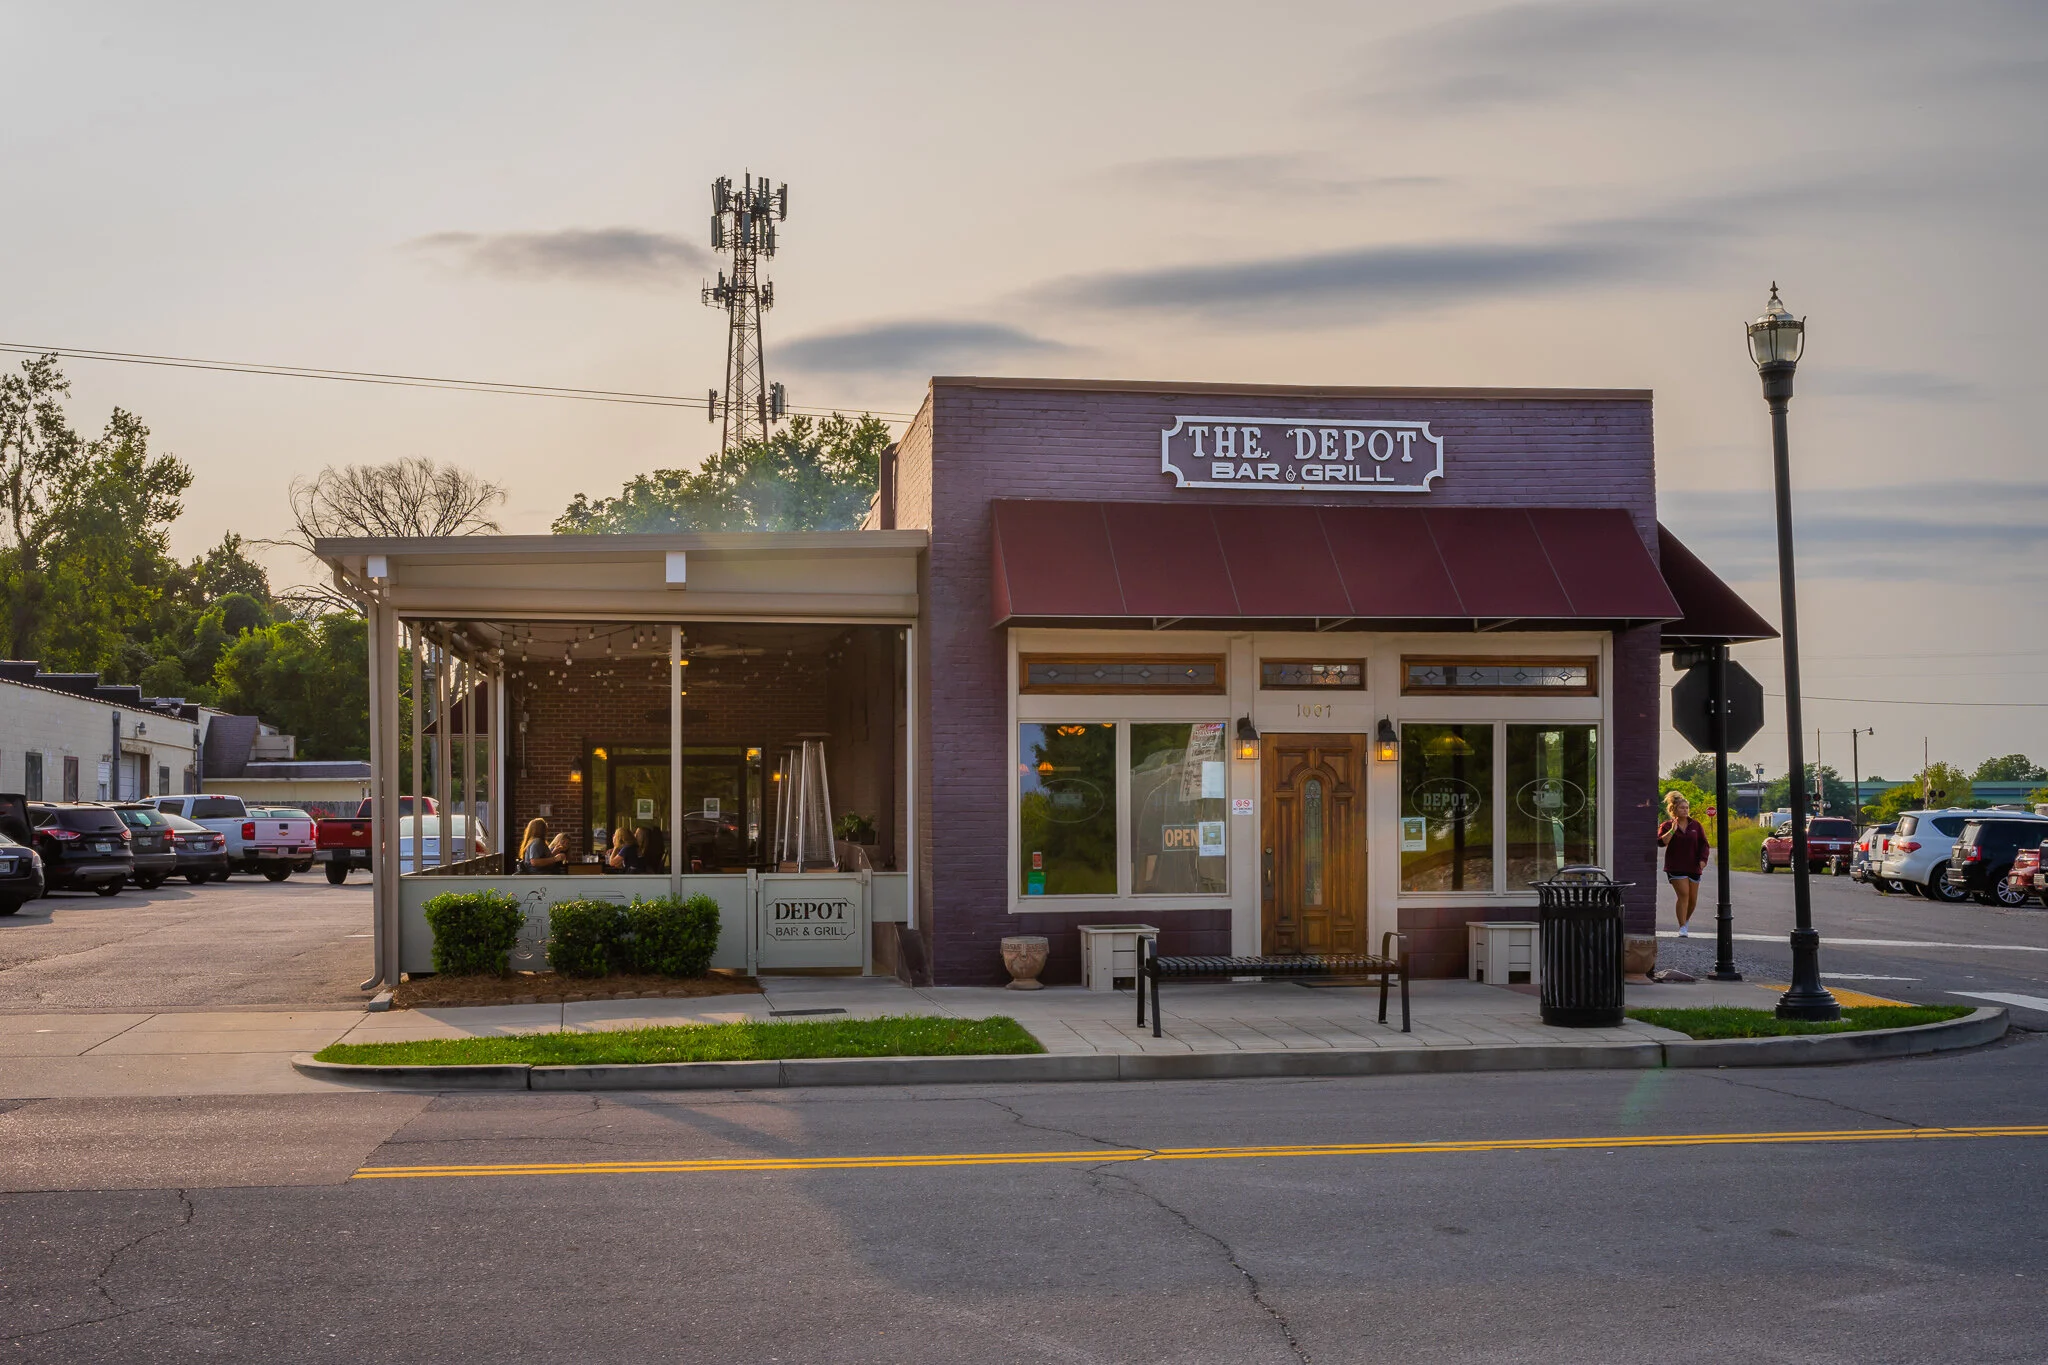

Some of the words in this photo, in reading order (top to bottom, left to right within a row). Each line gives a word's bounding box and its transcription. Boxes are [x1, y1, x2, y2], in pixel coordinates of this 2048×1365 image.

[1188, 426, 1262, 458] THE
[1293, 428, 1417, 462] DEPOT
[1211, 462, 1279, 480] BAR
[1301, 464, 1395, 482] GRILL
[1423, 793, 1470, 807] DEPOT
[1164, 829, 1200, 847] OPEN
[775, 902, 848, 920] DEPOT
[775, 926, 799, 936] BAR
[802, 926, 810, 936] &
[814, 926, 847, 936] GRILL
